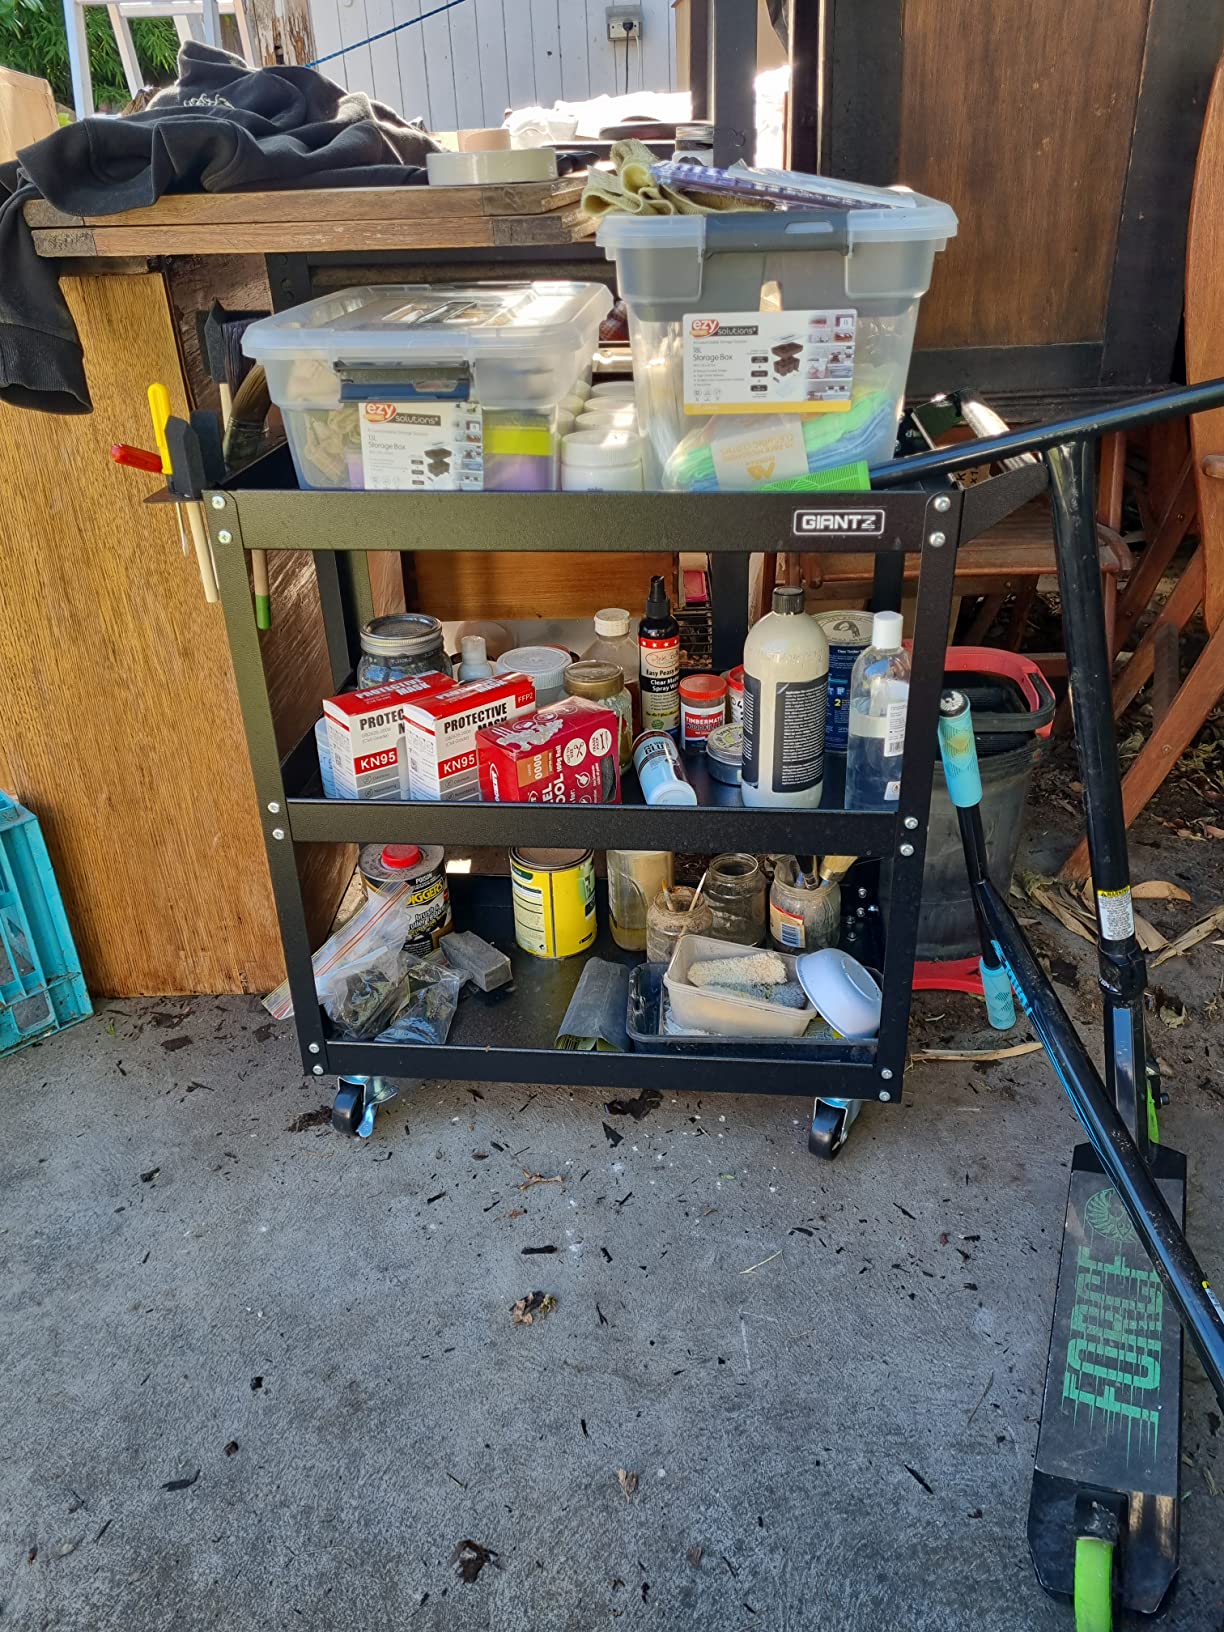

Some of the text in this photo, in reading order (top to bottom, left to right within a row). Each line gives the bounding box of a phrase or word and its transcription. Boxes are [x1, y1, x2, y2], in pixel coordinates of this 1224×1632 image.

[692, 320, 755, 336] ezy solutions
[692, 353, 733, 362] Storage Box
[366, 402, 438, 425] ezy solutions
[367, 441, 393, 450] Storage
[802, 514, 877, 529] GIANTZ
[652, 684, 670, 692] Spray
[517, 692, 534, 703] FFP2
[359, 708, 405, 731] PROTEC
[444, 702, 508, 734] PROTECTIVE
[360, 751, 396, 770] KN95
[443, 754, 475, 774] KN95
[415, 872, 433, 885] POISON
